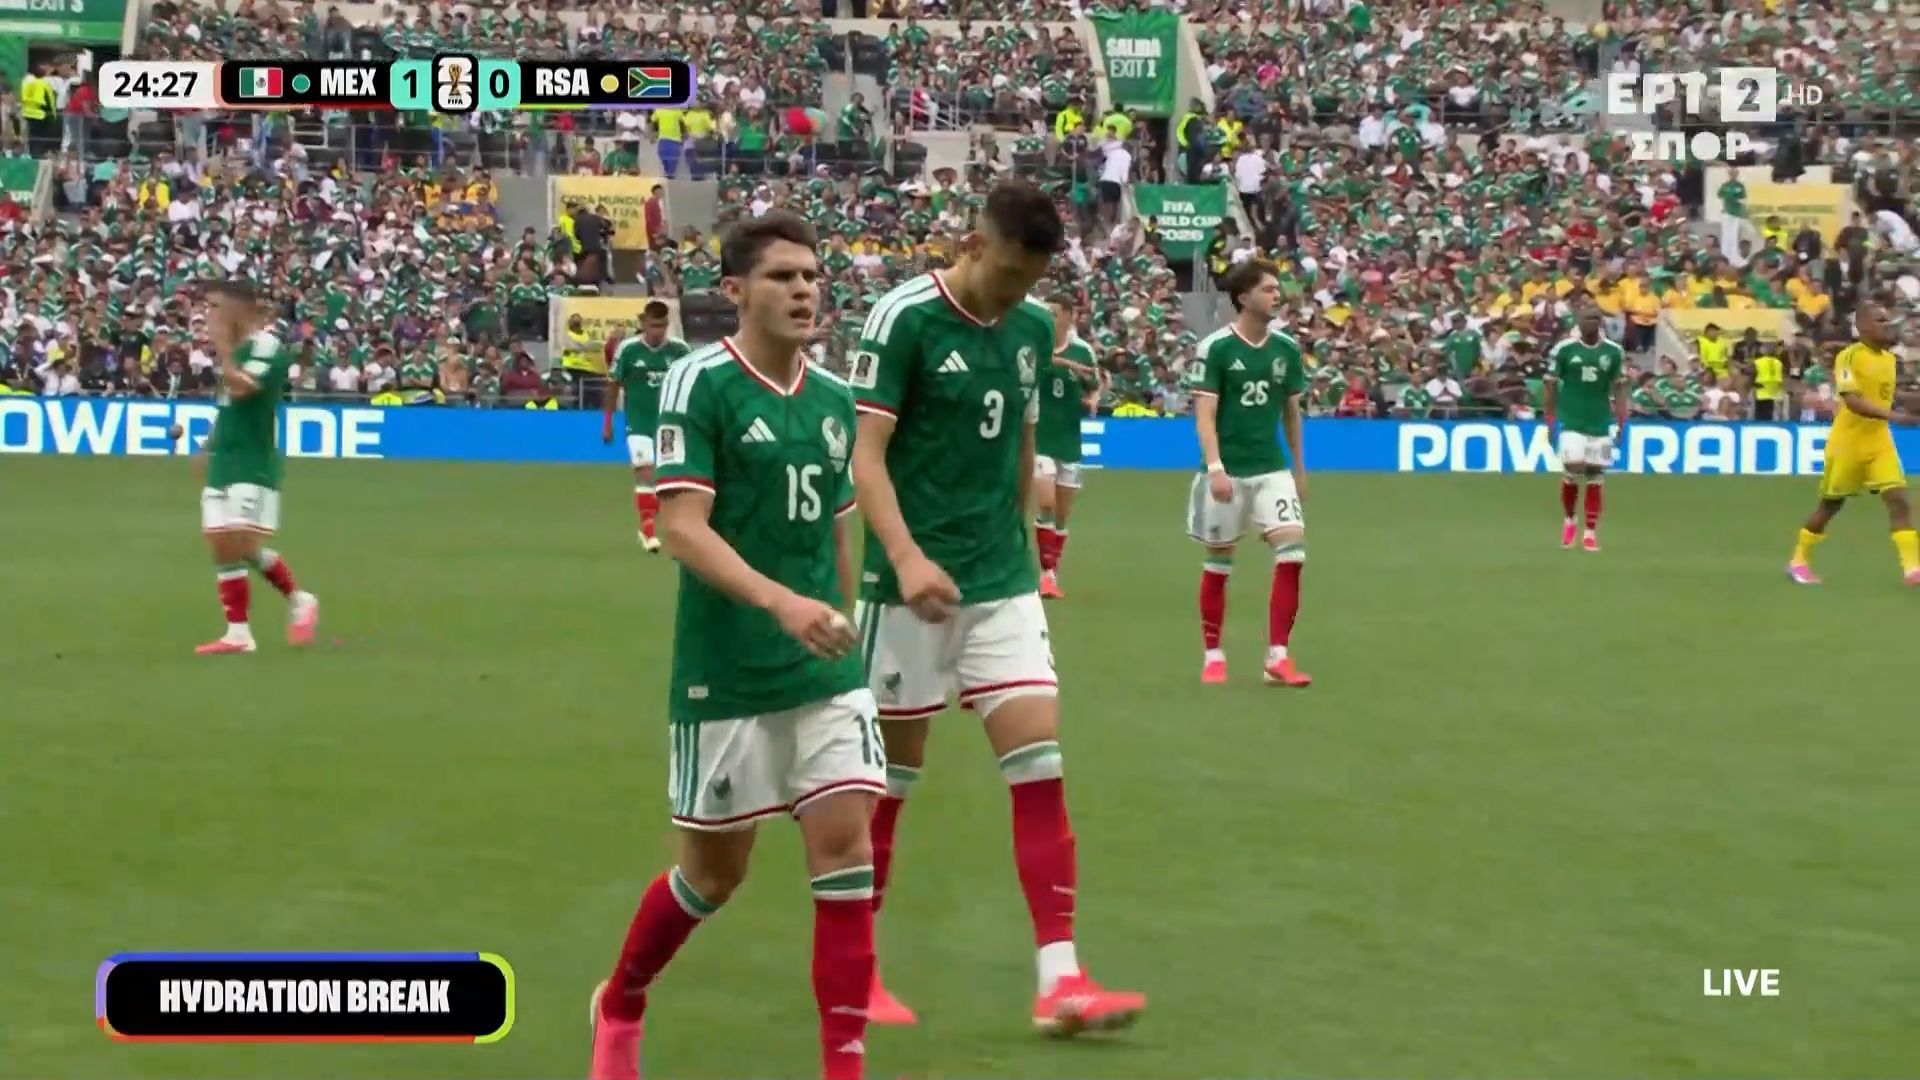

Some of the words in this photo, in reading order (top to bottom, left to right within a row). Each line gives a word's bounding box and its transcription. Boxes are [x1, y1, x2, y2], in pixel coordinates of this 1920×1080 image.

[1106, 38, 1161, 57] SALIDA
[1110, 59, 1145, 78] EXIT
[1147, 59, 1156, 78] 1
[1162, 200, 1196, 213] FIFA
[1240, 380, 1270, 407] 26
[0, 400, 385, 458] OWERDE
[980, 389, 1004, 439] 3
[1399, 422, 1827, 476] POWRADE
[786, 463, 822, 522] 15
